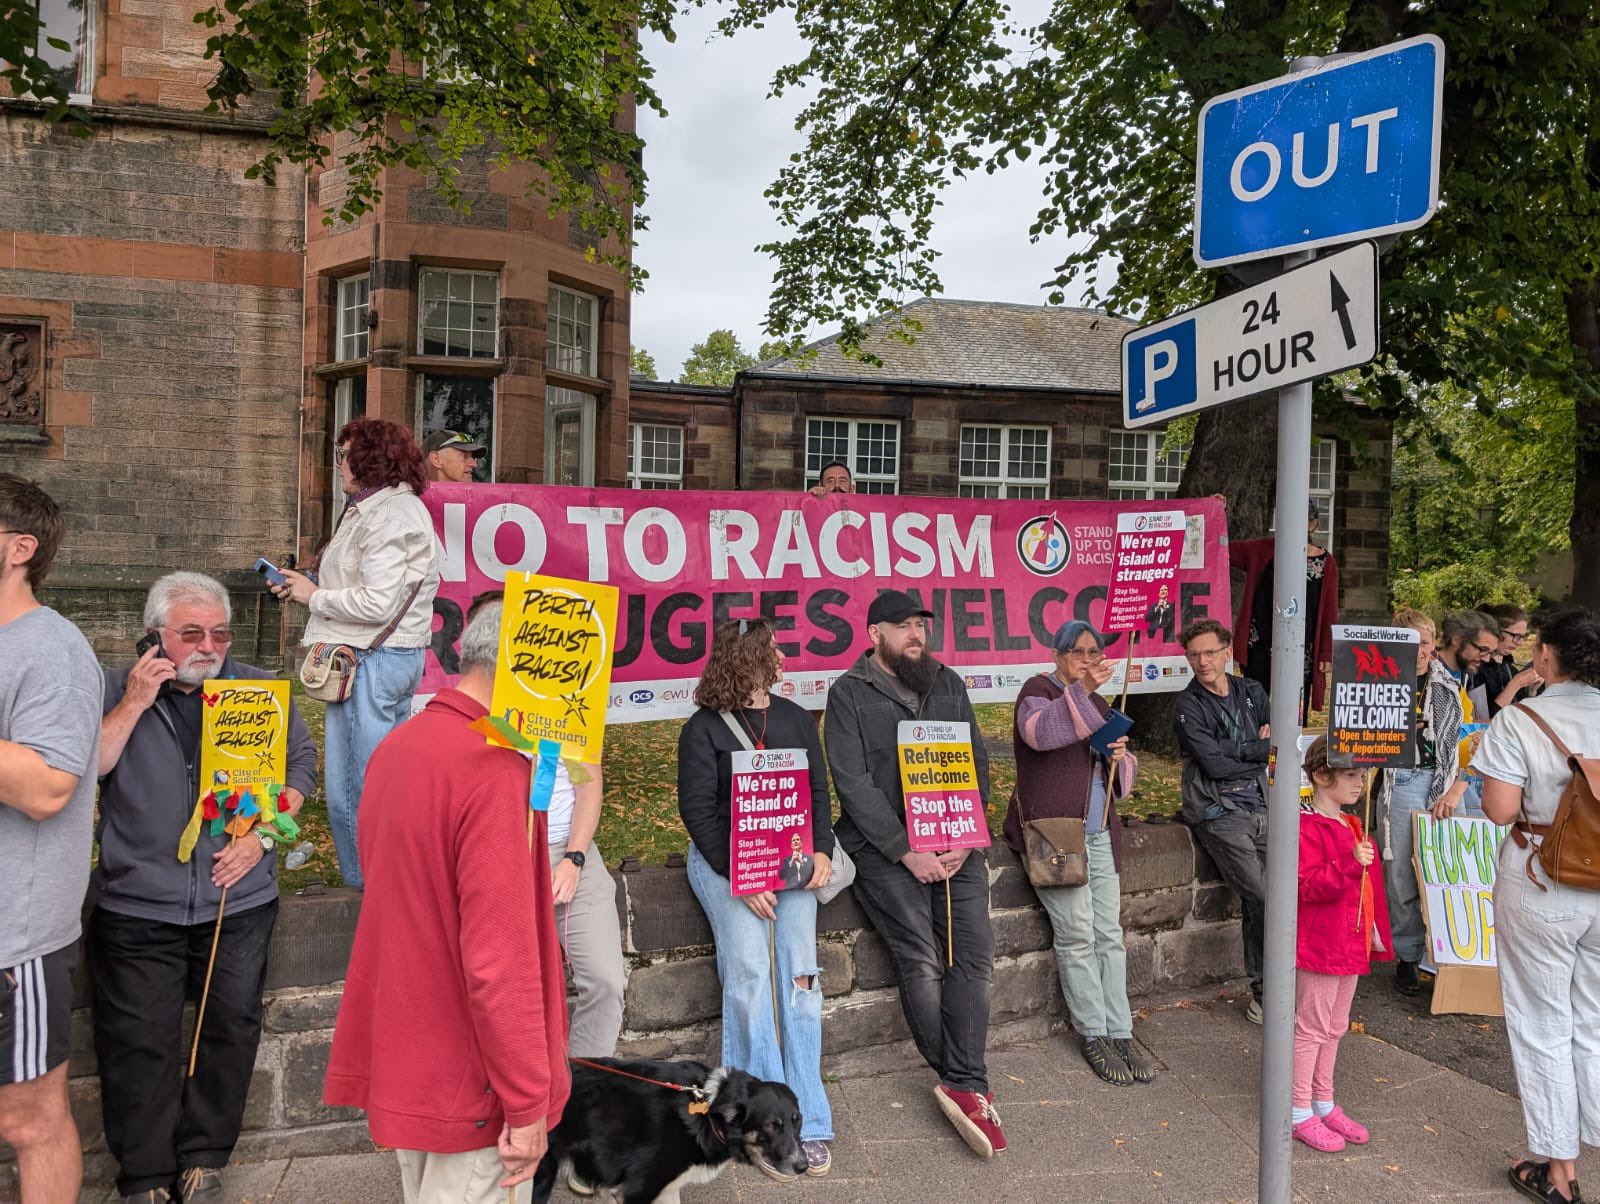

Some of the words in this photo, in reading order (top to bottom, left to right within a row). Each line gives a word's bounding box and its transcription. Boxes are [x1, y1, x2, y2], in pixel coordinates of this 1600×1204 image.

[1229, 106, 1398, 202] OUT
[1241, 290, 1281, 335] 24
[1212, 330, 1316, 392] HOUR
[1135, 338, 1179, 413] P
[1074, 526, 1113, 538] STAND
[434, 502, 547, 583] NO
[566, 506, 687, 583] TO
[709, 508, 995, 580] RACISM
[1075, 540, 1093, 551] UP
[1094, 539, 1112, 551] TO
[1120, 534, 1154, 549] We're
[1155, 536, 1171, 547] no
[1076, 552, 1114, 565] RACIS
[1157, 549, 1172, 564] of
[523, 588, 596, 623] PERTH
[512, 620, 599, 654] AGAINST
[510, 652, 593, 691] RACISM
[220, 689, 275, 707] PERTH
[633, 692, 652, 703] pcs
[1335, 682, 1411, 707] REFUGEES
[214, 709, 279, 729] AGAINST
[527, 712, 551, 729] City
[554, 717, 569, 729] of
[1334, 706, 1410, 730] WELCOME
[214, 728, 275, 749] RACISM
[525, 723, 588, 747] Sanctuary
[1340, 729, 1360, 742] Open
[1362, 730, 1375, 741] the
[1376, 730, 1407, 742] borders
[766, 753, 784, 762] STAND
[784, 752, 792, 761] UP
[903, 747, 970, 768] Refugees
[1339, 742, 1350, 753] No
[1352, 743, 1401, 755] deportations
[232, 768, 251, 778] City
[252, 768, 262, 776] of
[767, 761, 775, 769] TO
[775, 760, 795, 769] RACISM
[232, 775, 276, 785] Sanctuary
[737, 774, 776, 793] We're
[779, 776, 796, 790] no
[907, 767, 970, 785] welcome
[784, 792, 798, 809] of
[910, 796, 947, 818] Stop
[948, 795, 974, 812] the
[913, 818, 937, 837] far
[940, 815, 977, 838] right
[738, 838, 754, 849] Stop
[755, 838, 767, 846] the
[1419, 816, 1512, 885] HUMA
[738, 847, 780, 859] deportations
[738, 860, 767, 871] Migrants
[769, 857, 780, 867] and
[738, 870, 766, 881] refugees
[767, 869, 778, 878] are
[738, 880, 766, 891] welcome
